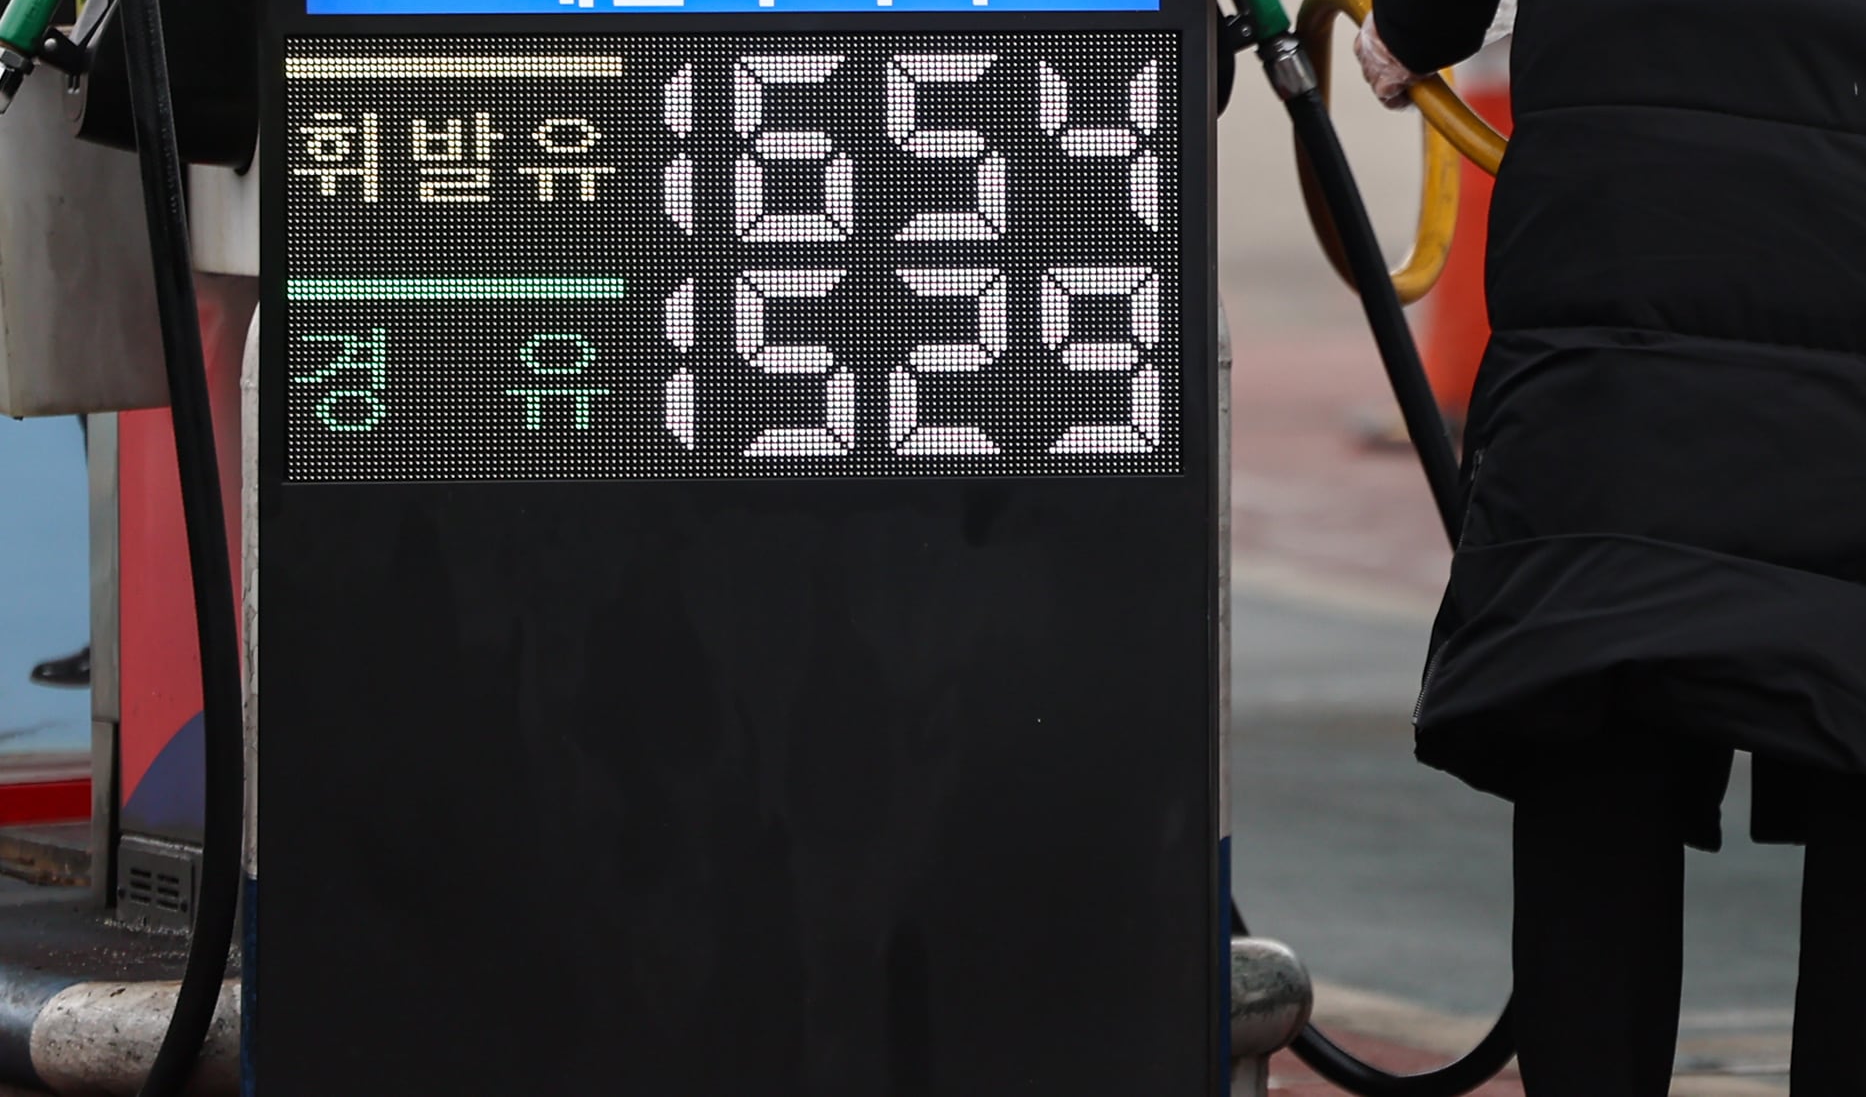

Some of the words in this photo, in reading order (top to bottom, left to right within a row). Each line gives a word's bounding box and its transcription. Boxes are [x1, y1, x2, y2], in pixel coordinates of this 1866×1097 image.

[293, 112, 617, 204] 휘발유
[662, 52, 1160, 243] 1654
[293, 326, 611, 431] 경유
[664, 267, 1162, 457] 1529
